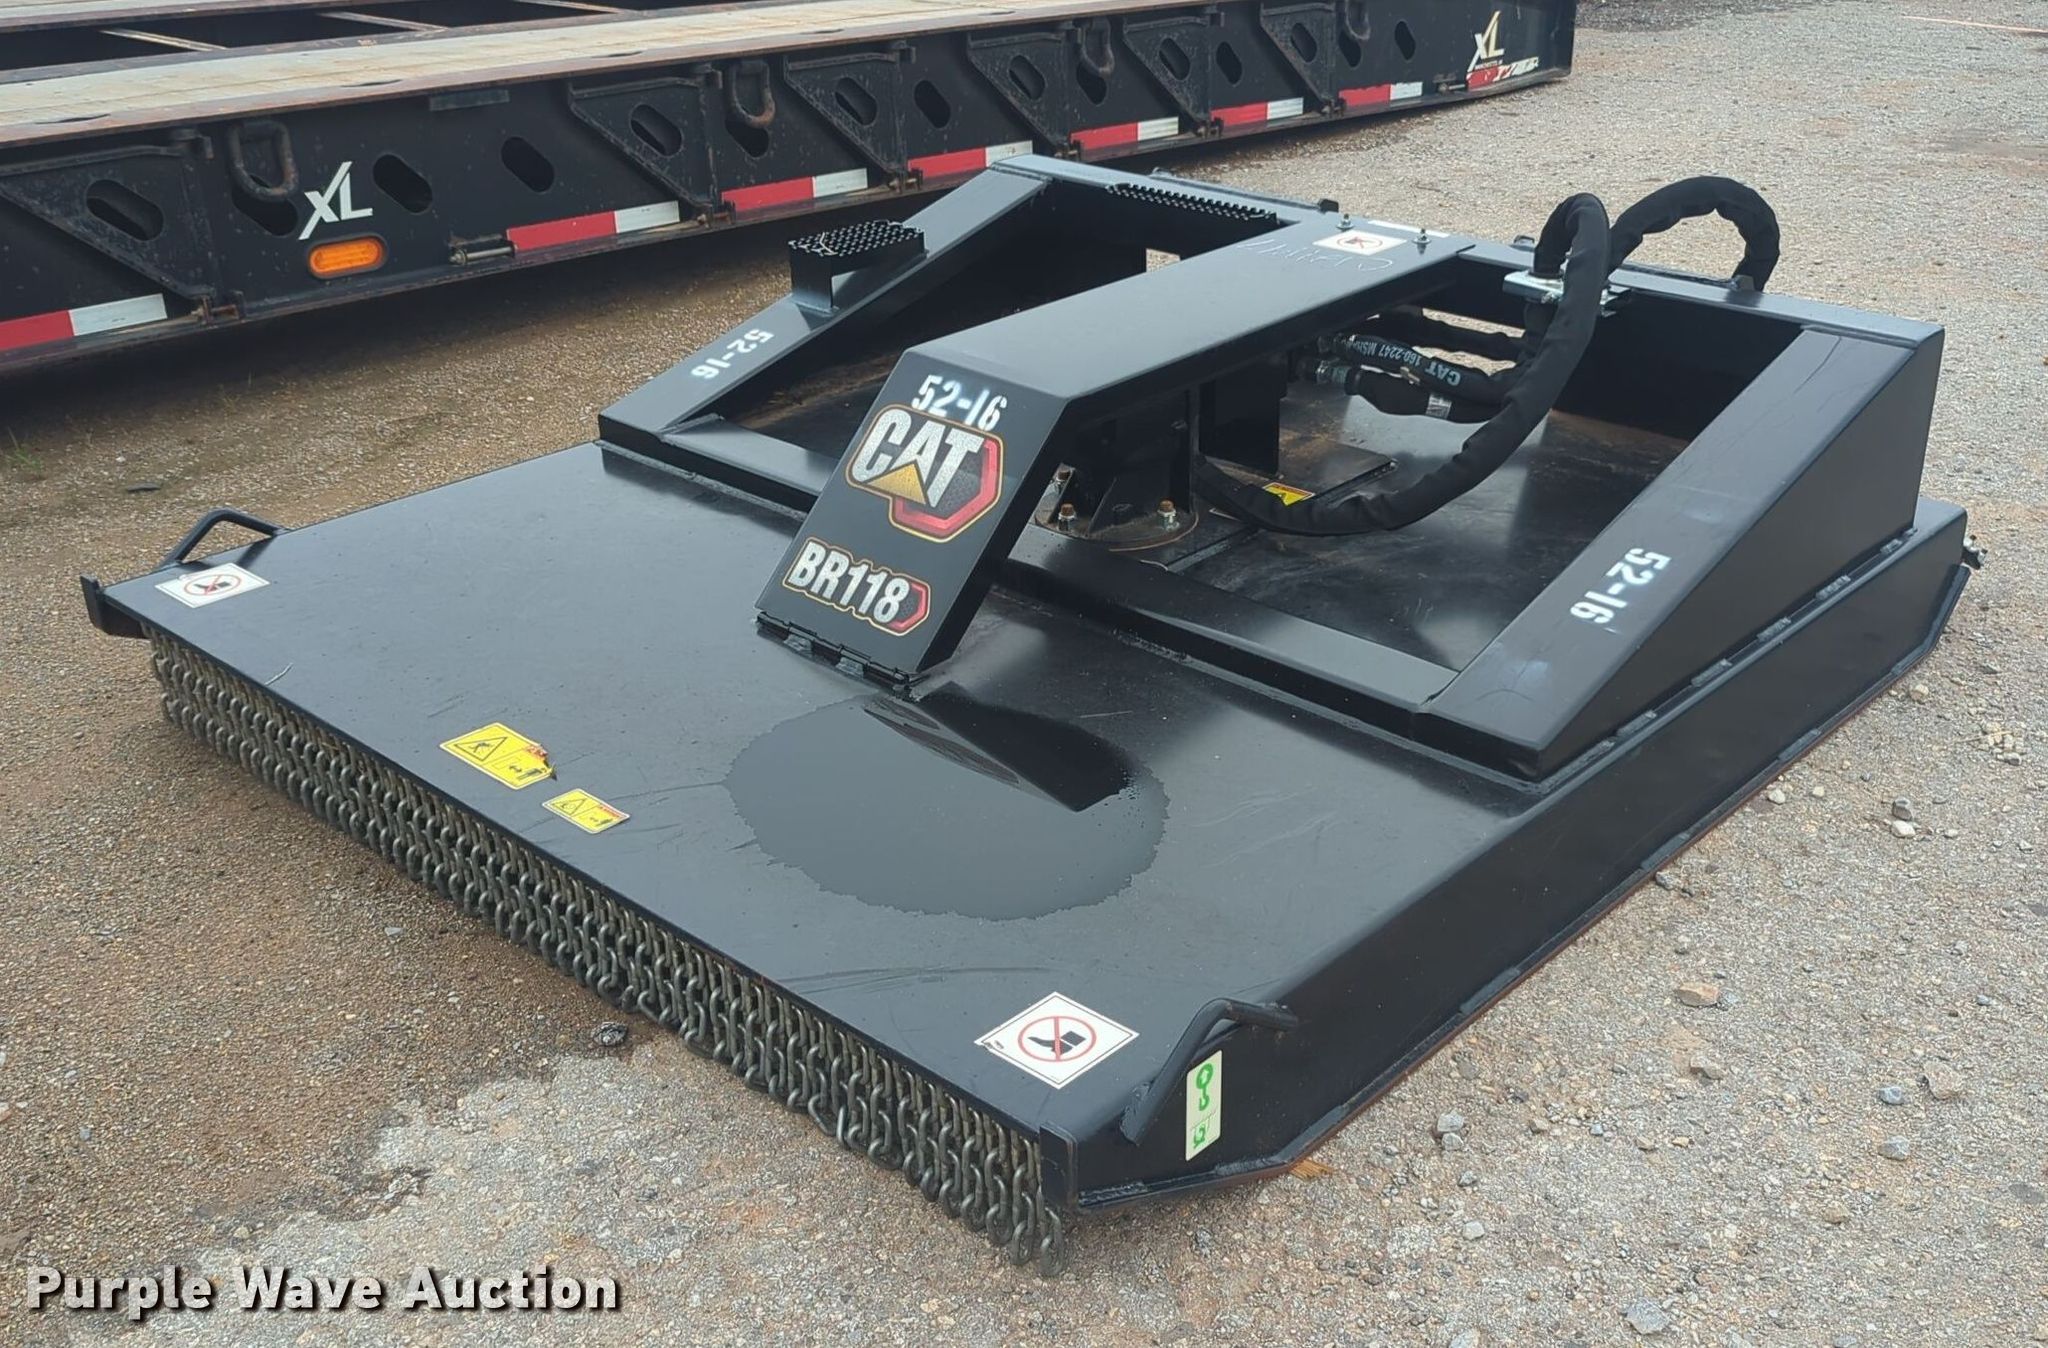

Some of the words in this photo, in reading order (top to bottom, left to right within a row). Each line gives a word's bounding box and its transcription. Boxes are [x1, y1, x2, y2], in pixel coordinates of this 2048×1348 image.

[298, 161, 373, 240] XL
[691, 329, 774, 379] 52-16
[1378, 343, 1422, 366] 160-2247
[1424, 361, 1461, 387] CAT
[911, 374, 1007, 432] 52-16
[851, 408, 985, 508] CAT
[788, 541, 911, 624] BR118
[1570, 548, 1672, 624] 52-16
